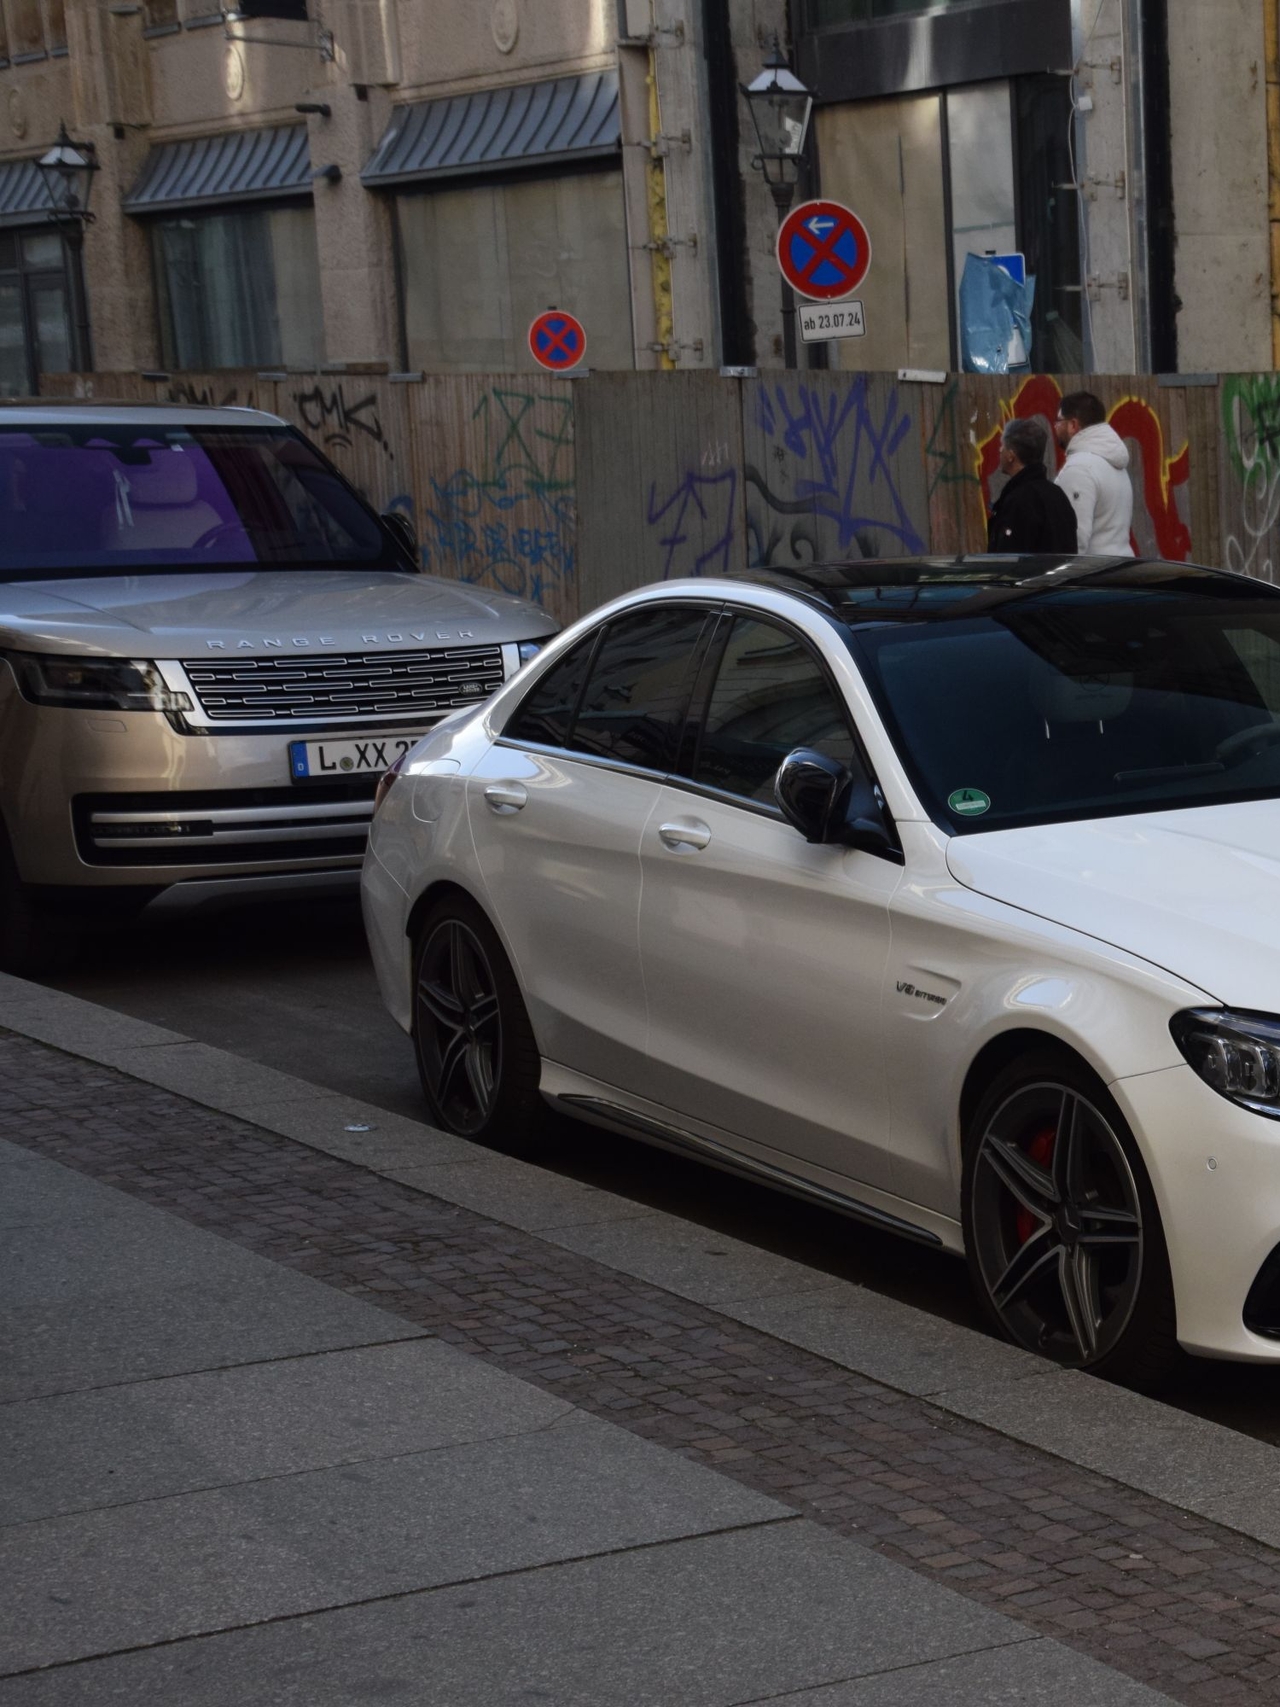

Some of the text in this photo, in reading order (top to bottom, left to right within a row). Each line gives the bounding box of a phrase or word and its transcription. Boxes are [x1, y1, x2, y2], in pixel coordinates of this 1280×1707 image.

[804, 312, 861, 331] ab 23.07.24
[206, 629, 475, 650] RANGE ROVER
[318, 746, 337, 770] L
[355, 742, 389, 768] XX
